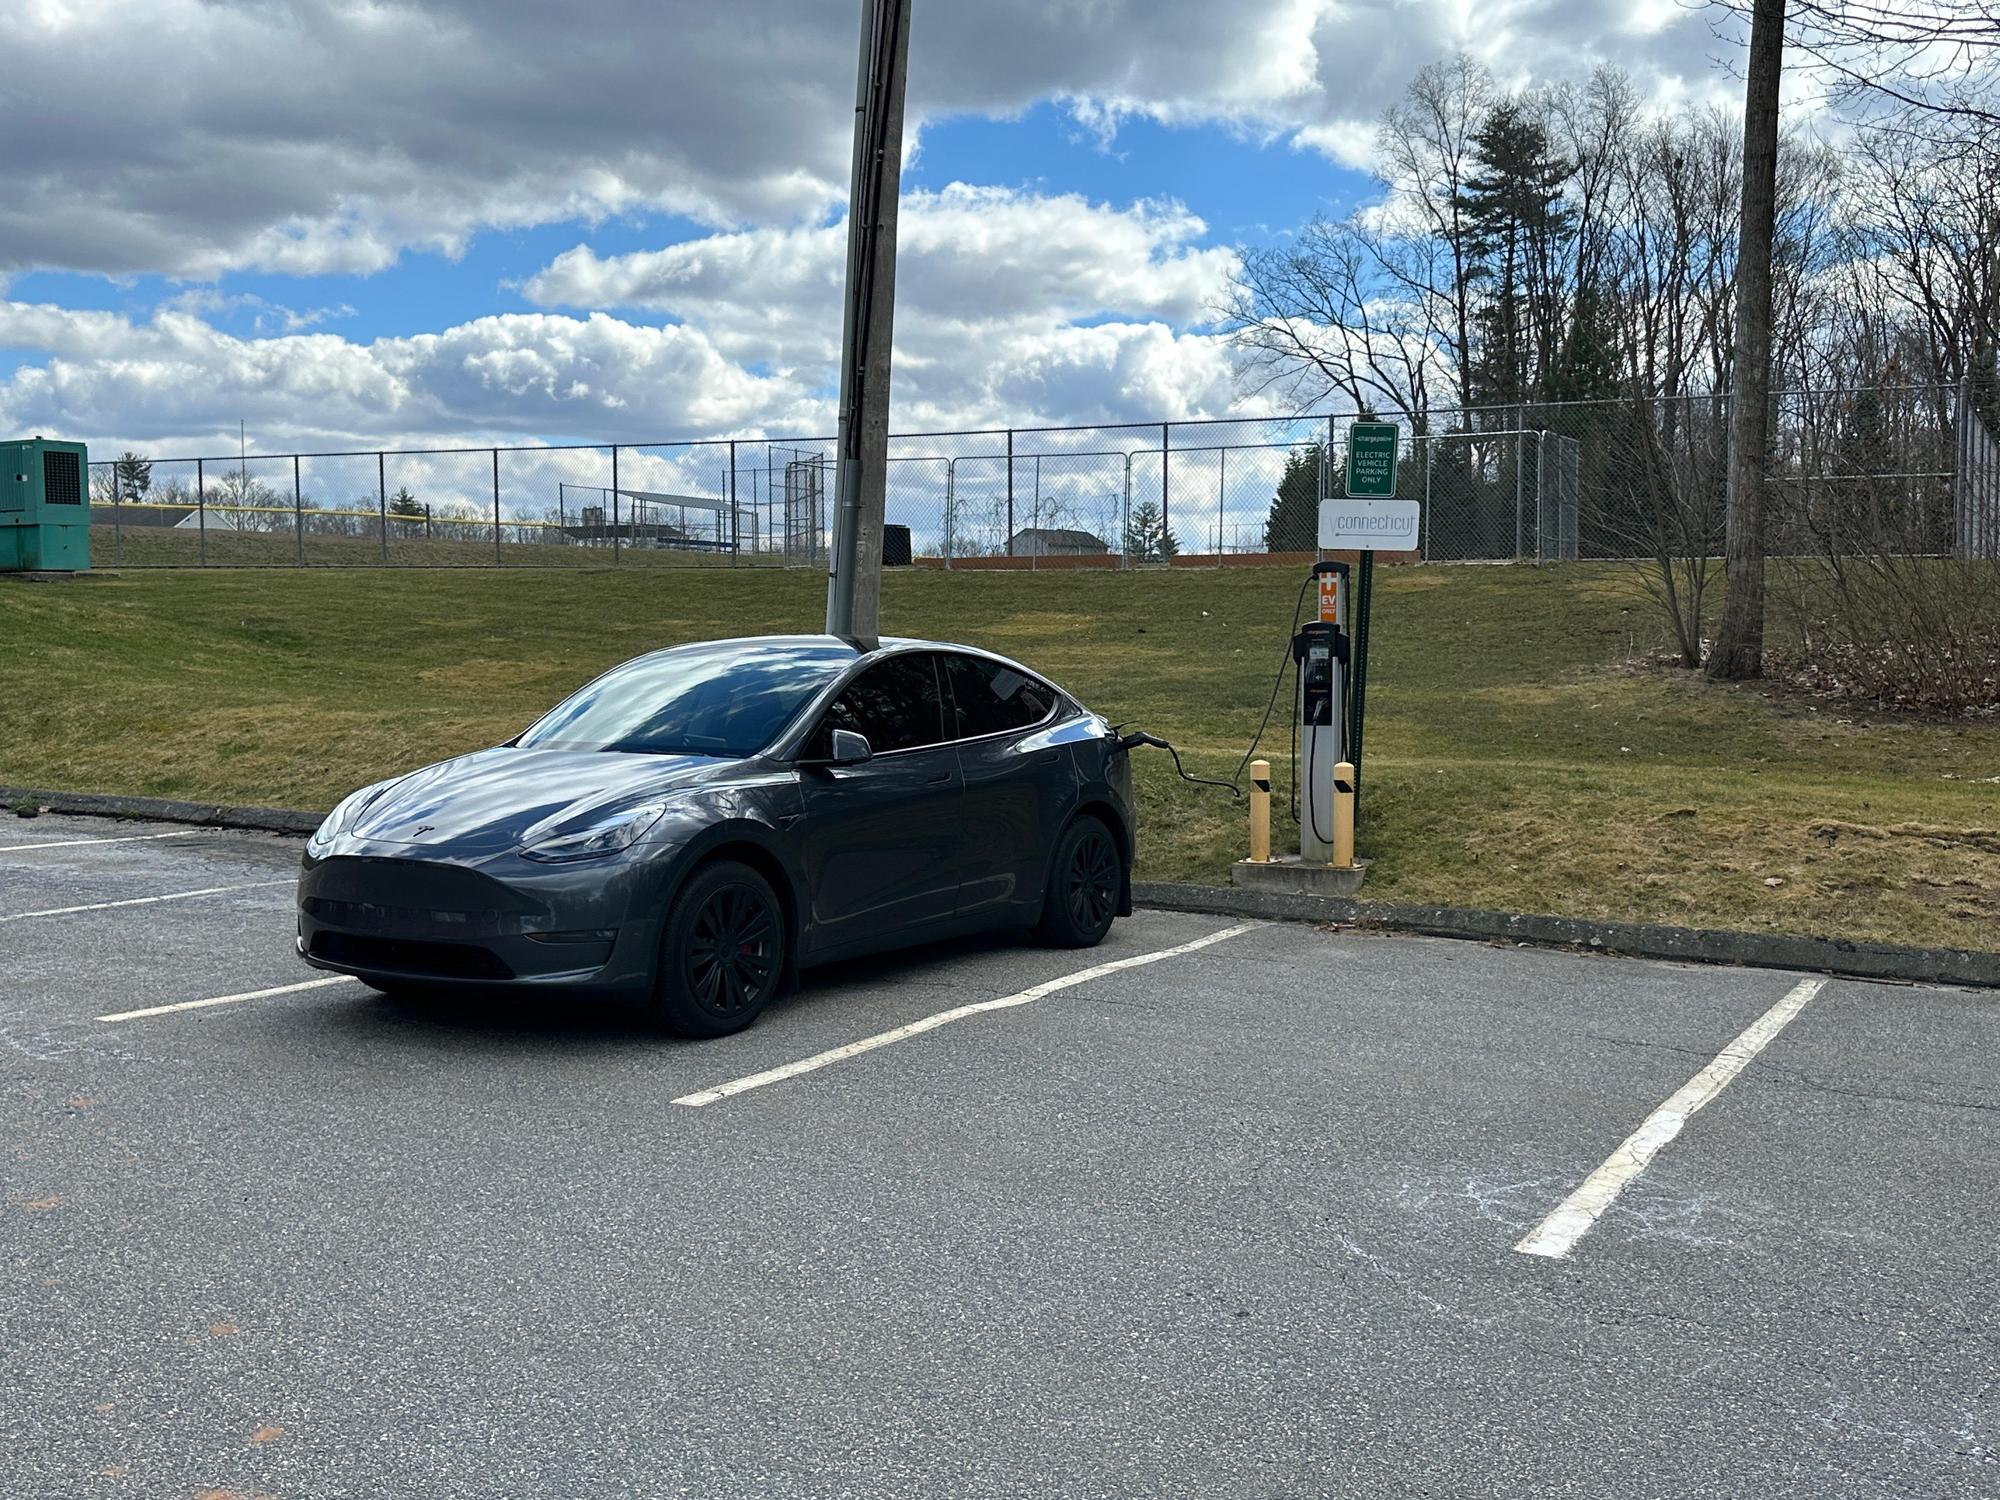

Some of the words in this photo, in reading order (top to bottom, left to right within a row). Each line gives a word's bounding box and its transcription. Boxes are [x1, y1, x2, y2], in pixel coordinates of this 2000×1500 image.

[1355, 451, 1391, 459] ELECTRIC
[1361, 476, 1382, 484] ONLY
[1322, 595, 1336, 605] EV
